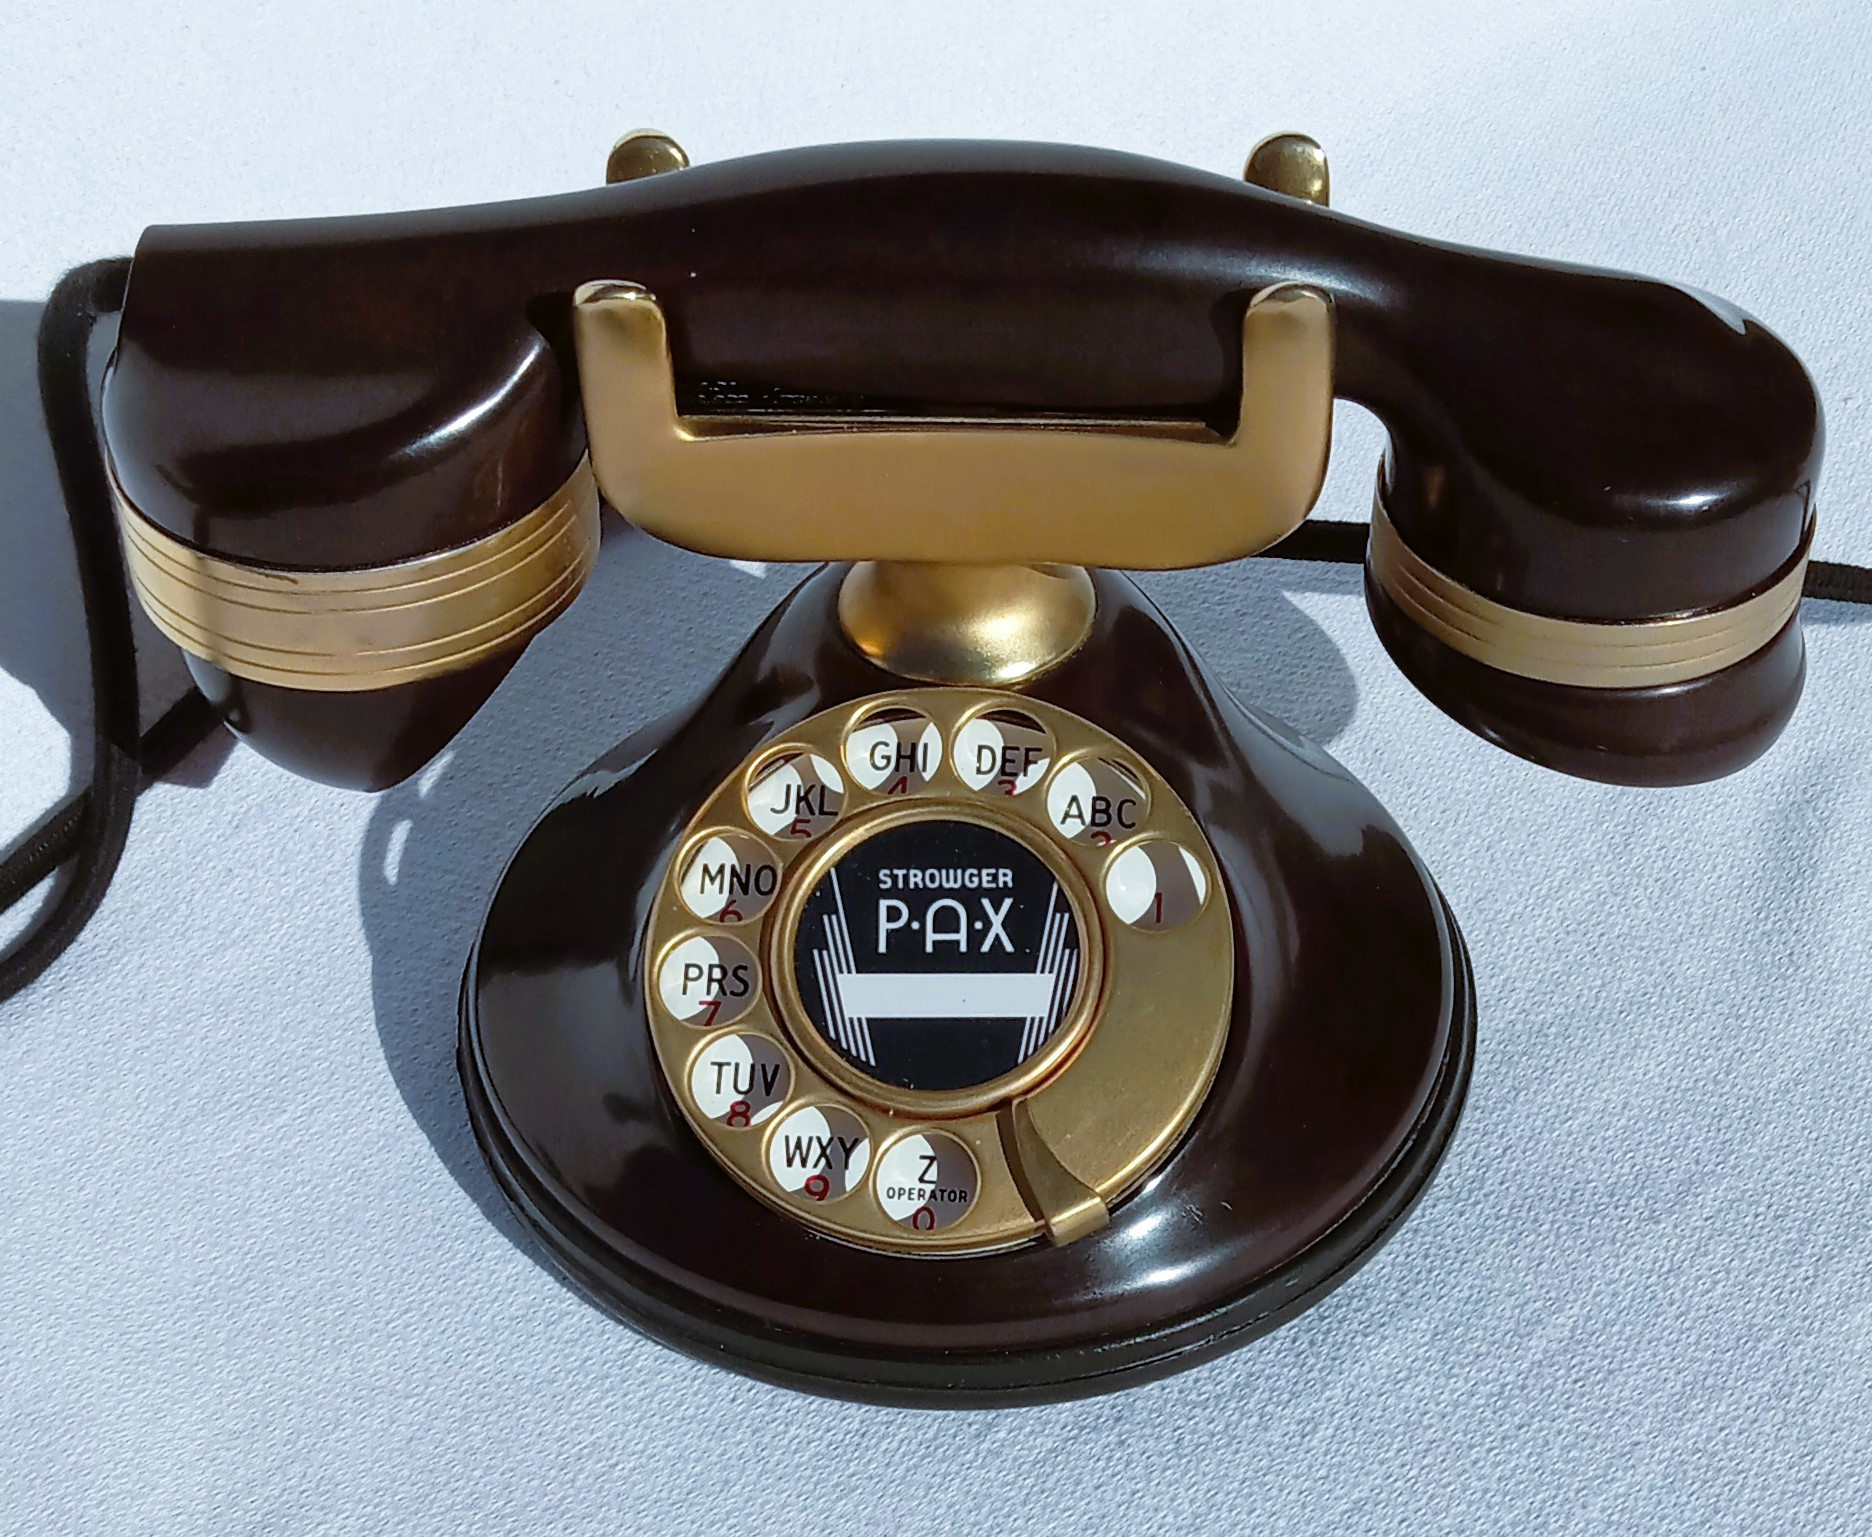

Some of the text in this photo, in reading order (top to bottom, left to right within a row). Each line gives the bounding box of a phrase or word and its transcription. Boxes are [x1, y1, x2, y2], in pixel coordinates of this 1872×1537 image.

[869, 741, 929, 773] GHI
[976, 745, 1042, 777] DEF
[770, 784, 839, 817] JKL
[1060, 794, 1137, 830] ABC
[699, 863, 778, 896] MNO
[878, 868, 1014, 889] STROWGER
[1155, 892, 1163, 924] 1
[682, 963, 750, 997] PRS
[699, 1001, 722, 1027] 7
[710, 1061, 781, 1097] TUV
[726, 1100, 751, 1128] 8
[784, 1135, 859, 1170] WXY
[918, 1155, 938, 1185] Z
[804, 1174, 831, 1201] 9
[886, 1187, 968, 1203] OPERATOR
